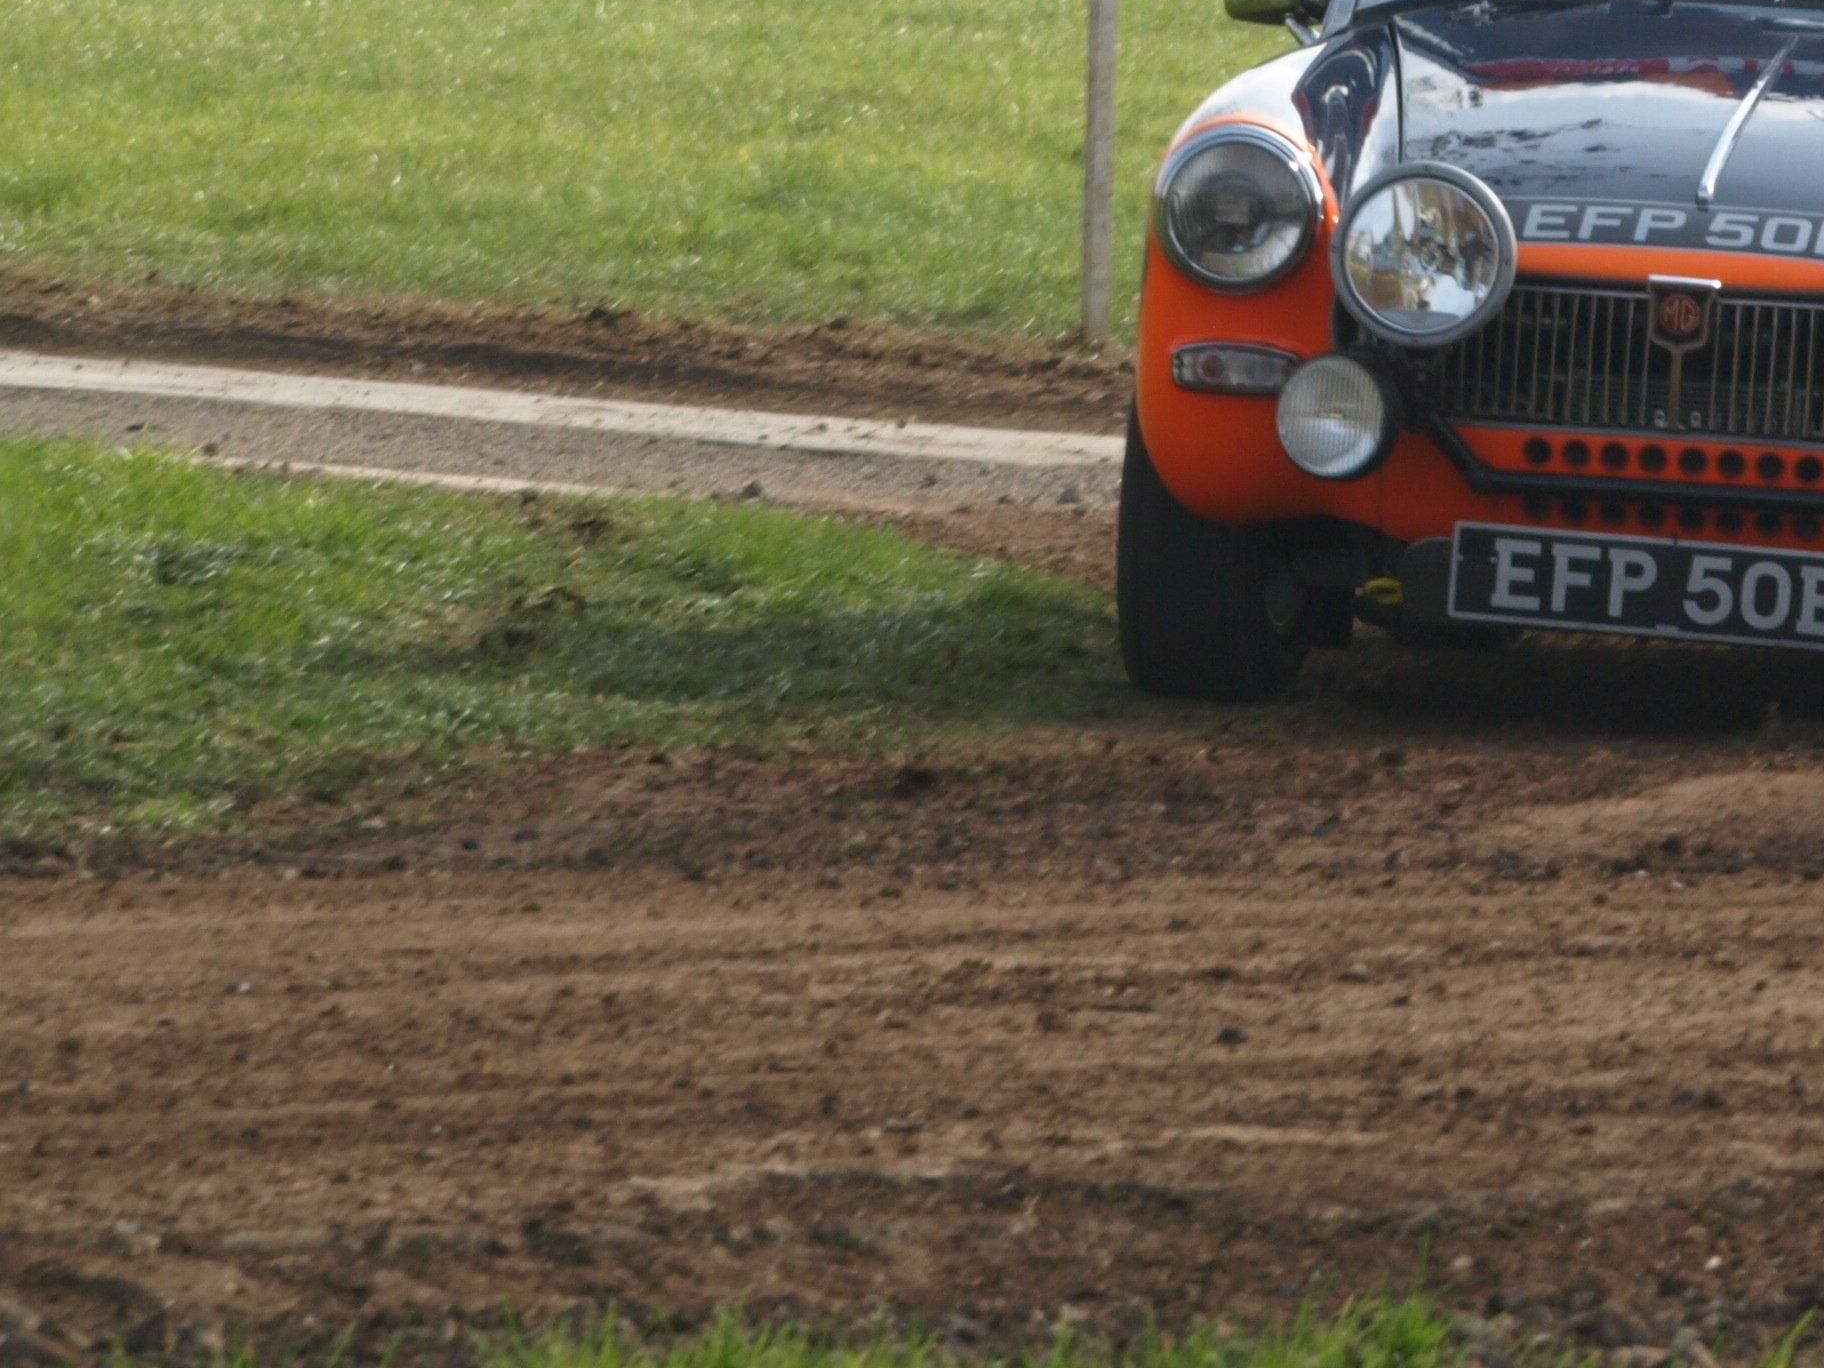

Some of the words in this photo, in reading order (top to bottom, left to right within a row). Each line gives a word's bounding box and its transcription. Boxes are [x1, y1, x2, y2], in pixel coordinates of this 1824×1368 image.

[1522, 204, 1687, 242] EFP
[1662, 296, 1699, 331] MG
[1490, 537, 1659, 619] EFP
